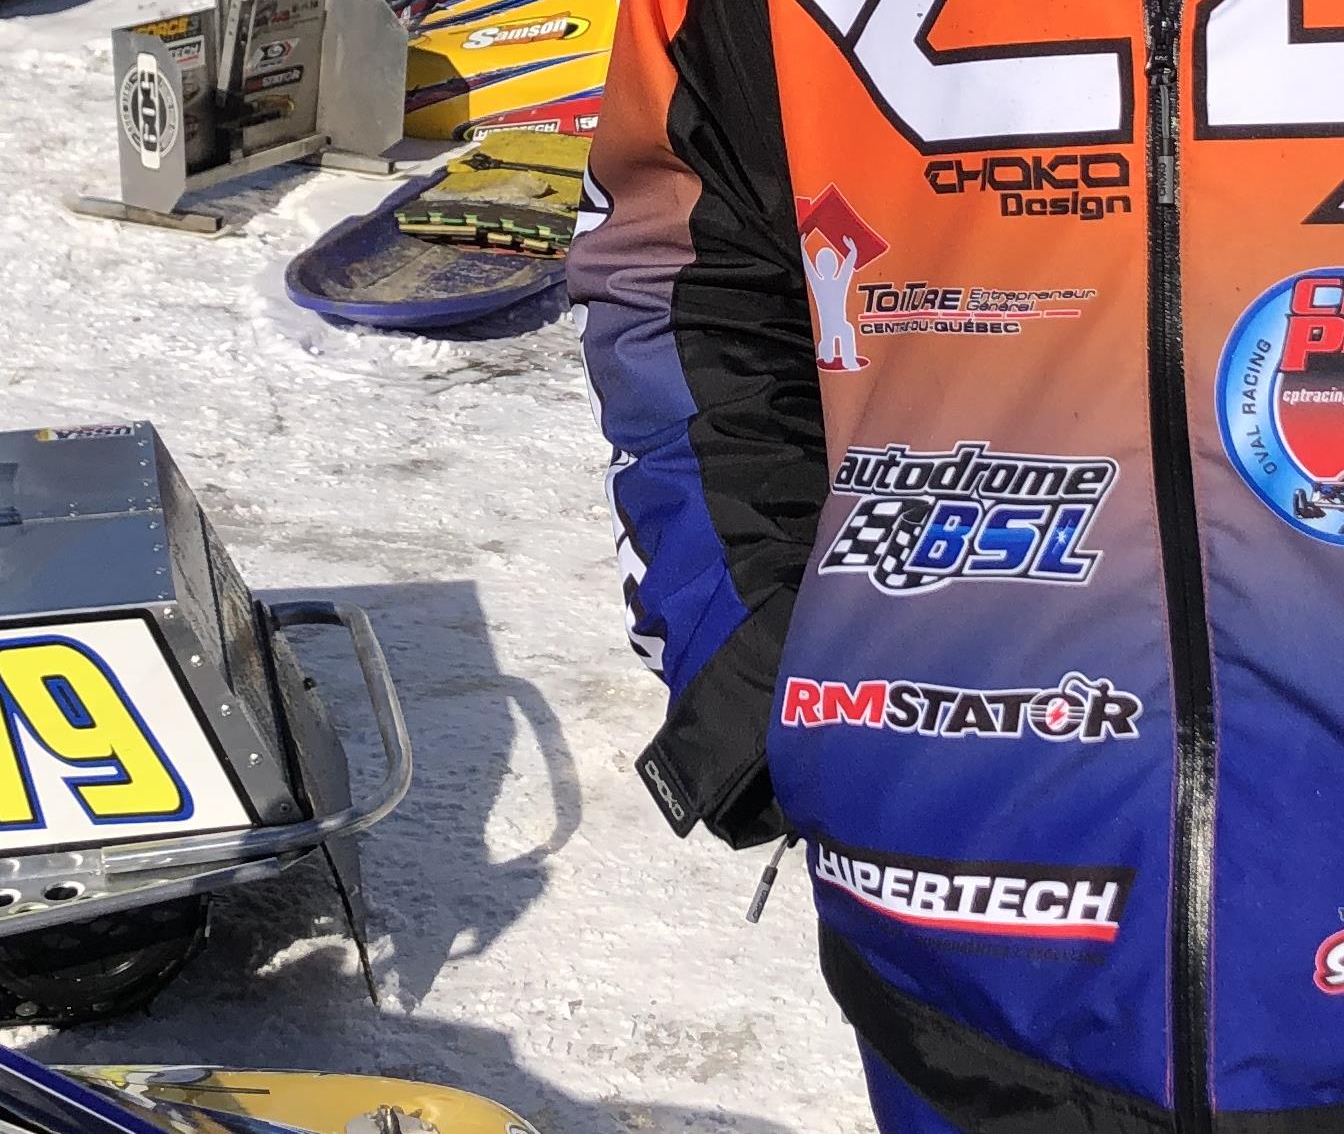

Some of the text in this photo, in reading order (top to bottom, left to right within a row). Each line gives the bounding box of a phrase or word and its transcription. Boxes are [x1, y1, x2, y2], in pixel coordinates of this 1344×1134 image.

[462, 17, 569, 50] Samson
[924, 152, 1130, 195] CHOKO
[1000, 190, 1132, 221] Design
[1241, 338, 1278, 475] OVAL RACING
[832, 444, 1109, 496] autodrome
[903, 499, 1096, 580] BSL
[781, 672, 1144, 743] RMSTATOR
[816, 841, 1119, 926] HIPERTECH
